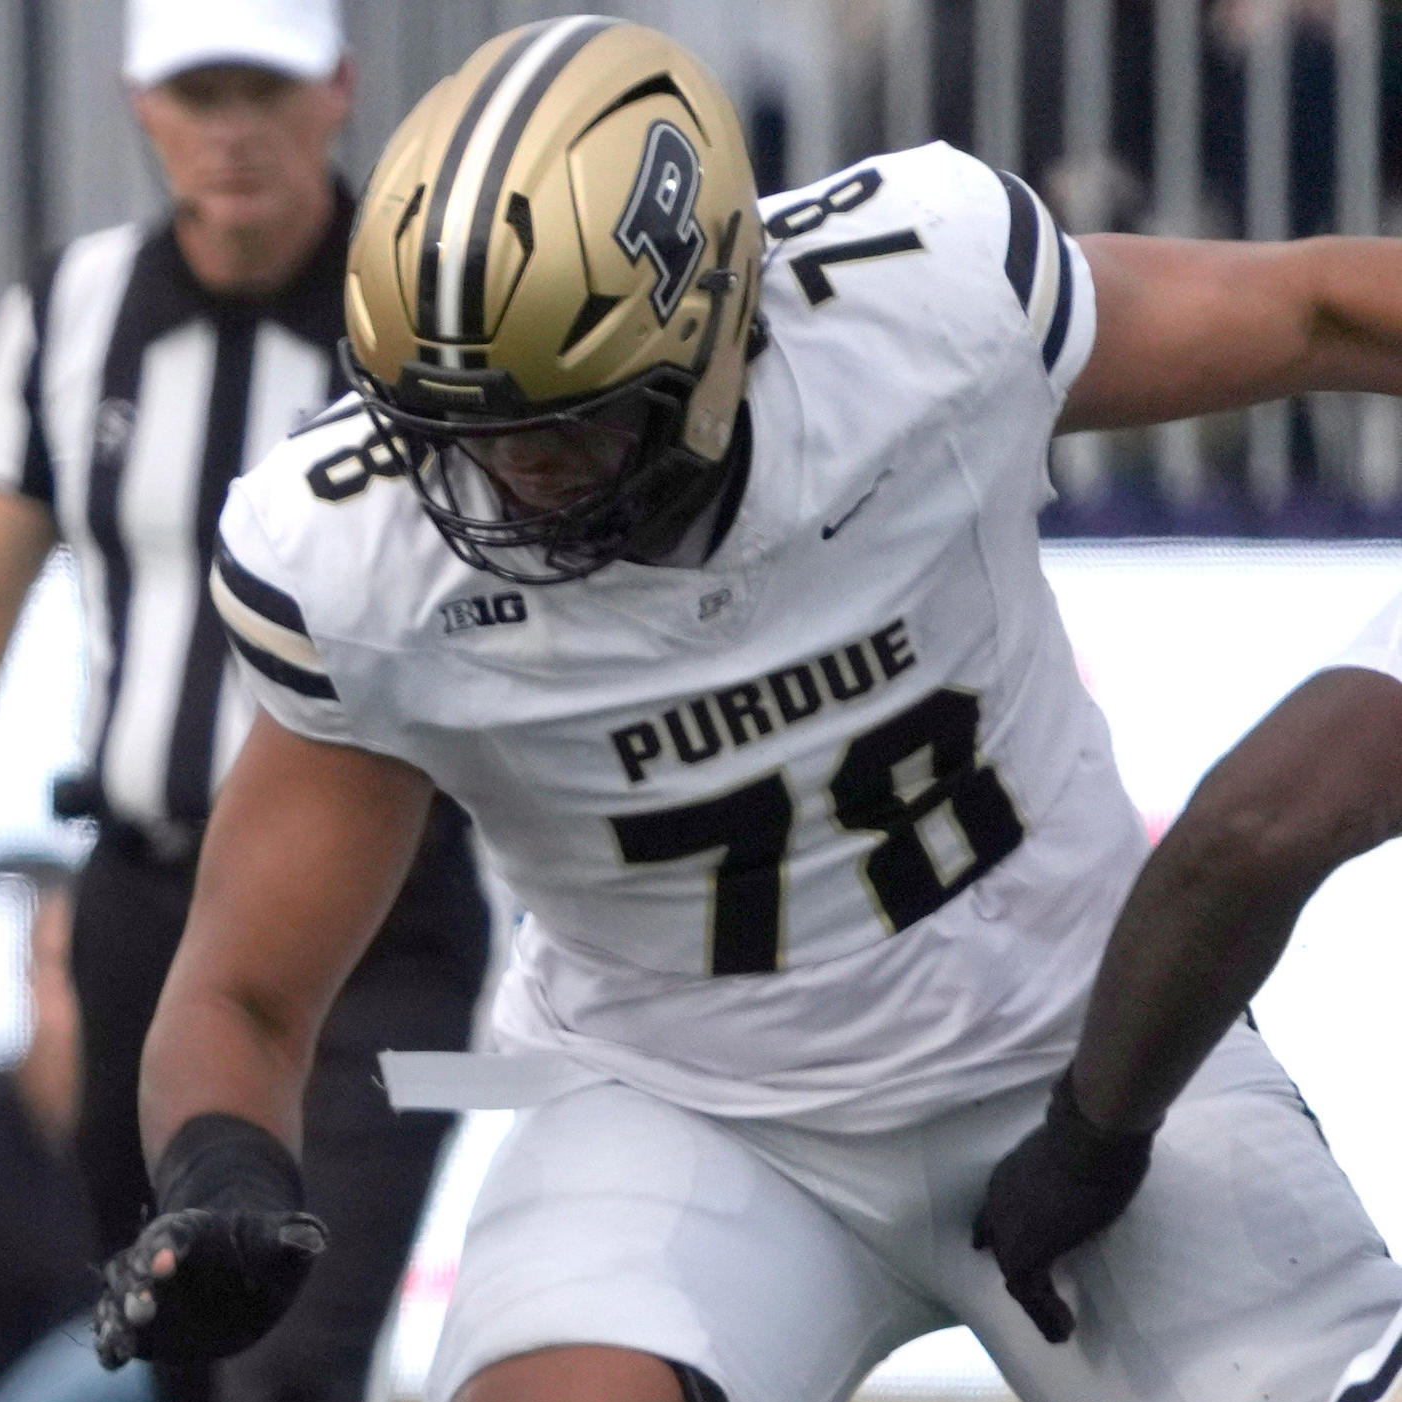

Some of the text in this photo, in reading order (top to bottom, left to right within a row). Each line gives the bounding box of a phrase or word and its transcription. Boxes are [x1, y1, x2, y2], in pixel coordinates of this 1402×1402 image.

[613, 118, 707, 328] P
[610, 617, 917, 784] PURDUE
[606, 680, 1028, 976] 78
